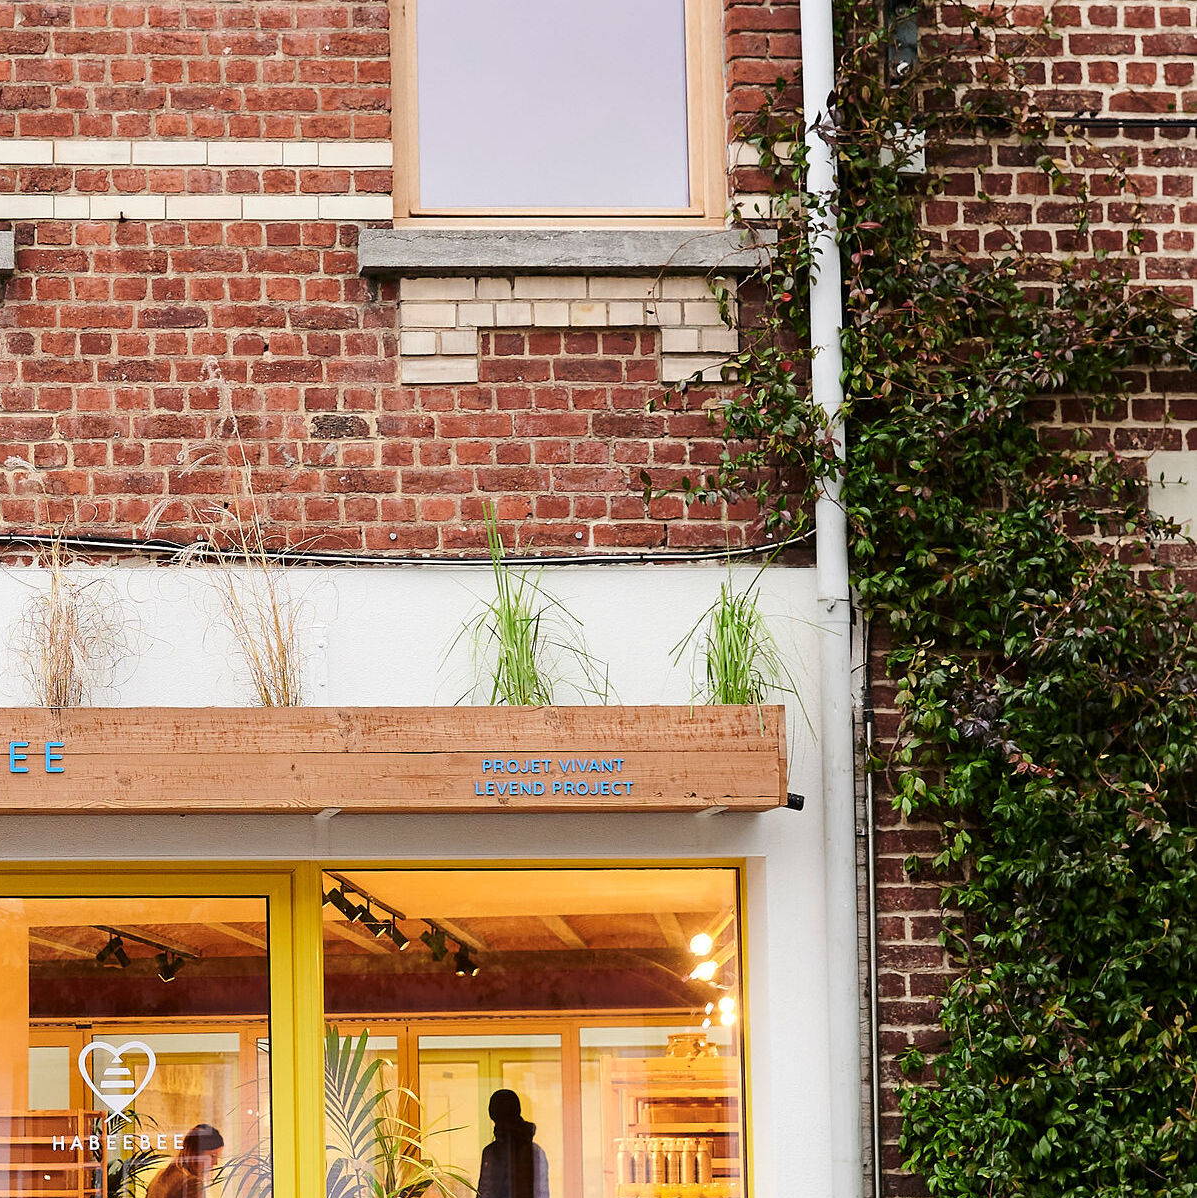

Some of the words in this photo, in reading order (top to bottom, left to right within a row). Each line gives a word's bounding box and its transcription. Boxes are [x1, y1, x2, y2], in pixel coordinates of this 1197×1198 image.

[482, 759, 551, 773] PROJET
[558, 758, 625, 773] VIVANT
[474, 781, 545, 796] LEVEND
[552, 781, 634, 796] PROJECT
[52, 1134, 185, 1151] HABEEBEE
